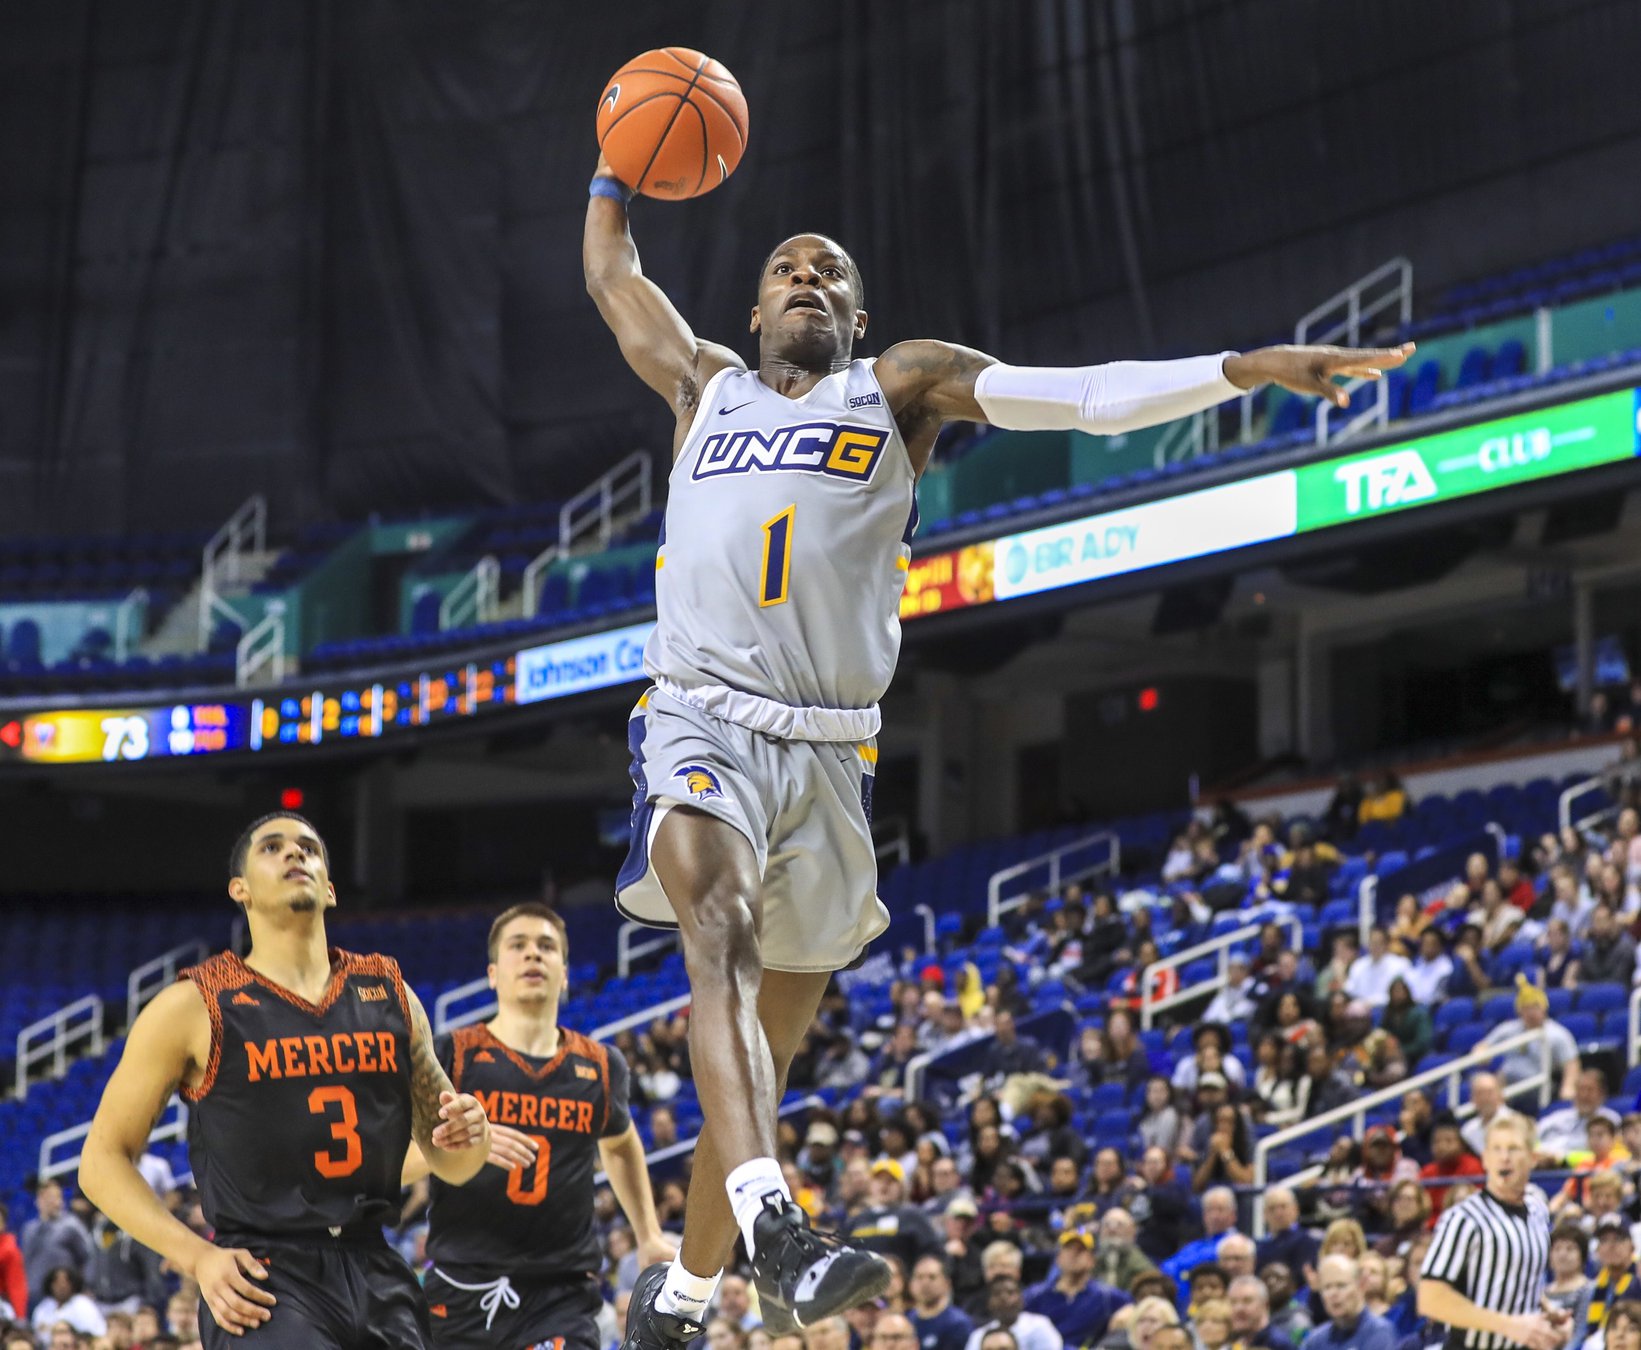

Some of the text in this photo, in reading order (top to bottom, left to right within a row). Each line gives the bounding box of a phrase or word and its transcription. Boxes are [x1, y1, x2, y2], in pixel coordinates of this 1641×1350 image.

[691, 421, 890, 483] UNCG
[1334, 427, 1551, 514] TFA CLUB
[759, 503, 796, 608] 1
[1034, 523, 1140, 574] BRADY
[101, 716, 148, 761] 73
[244, 1031, 398, 1082] MERCER
[307, 1085, 362, 1179] 3
[473, 1089, 594, 1134] MERCER
[506, 1133, 551, 1206] 0
